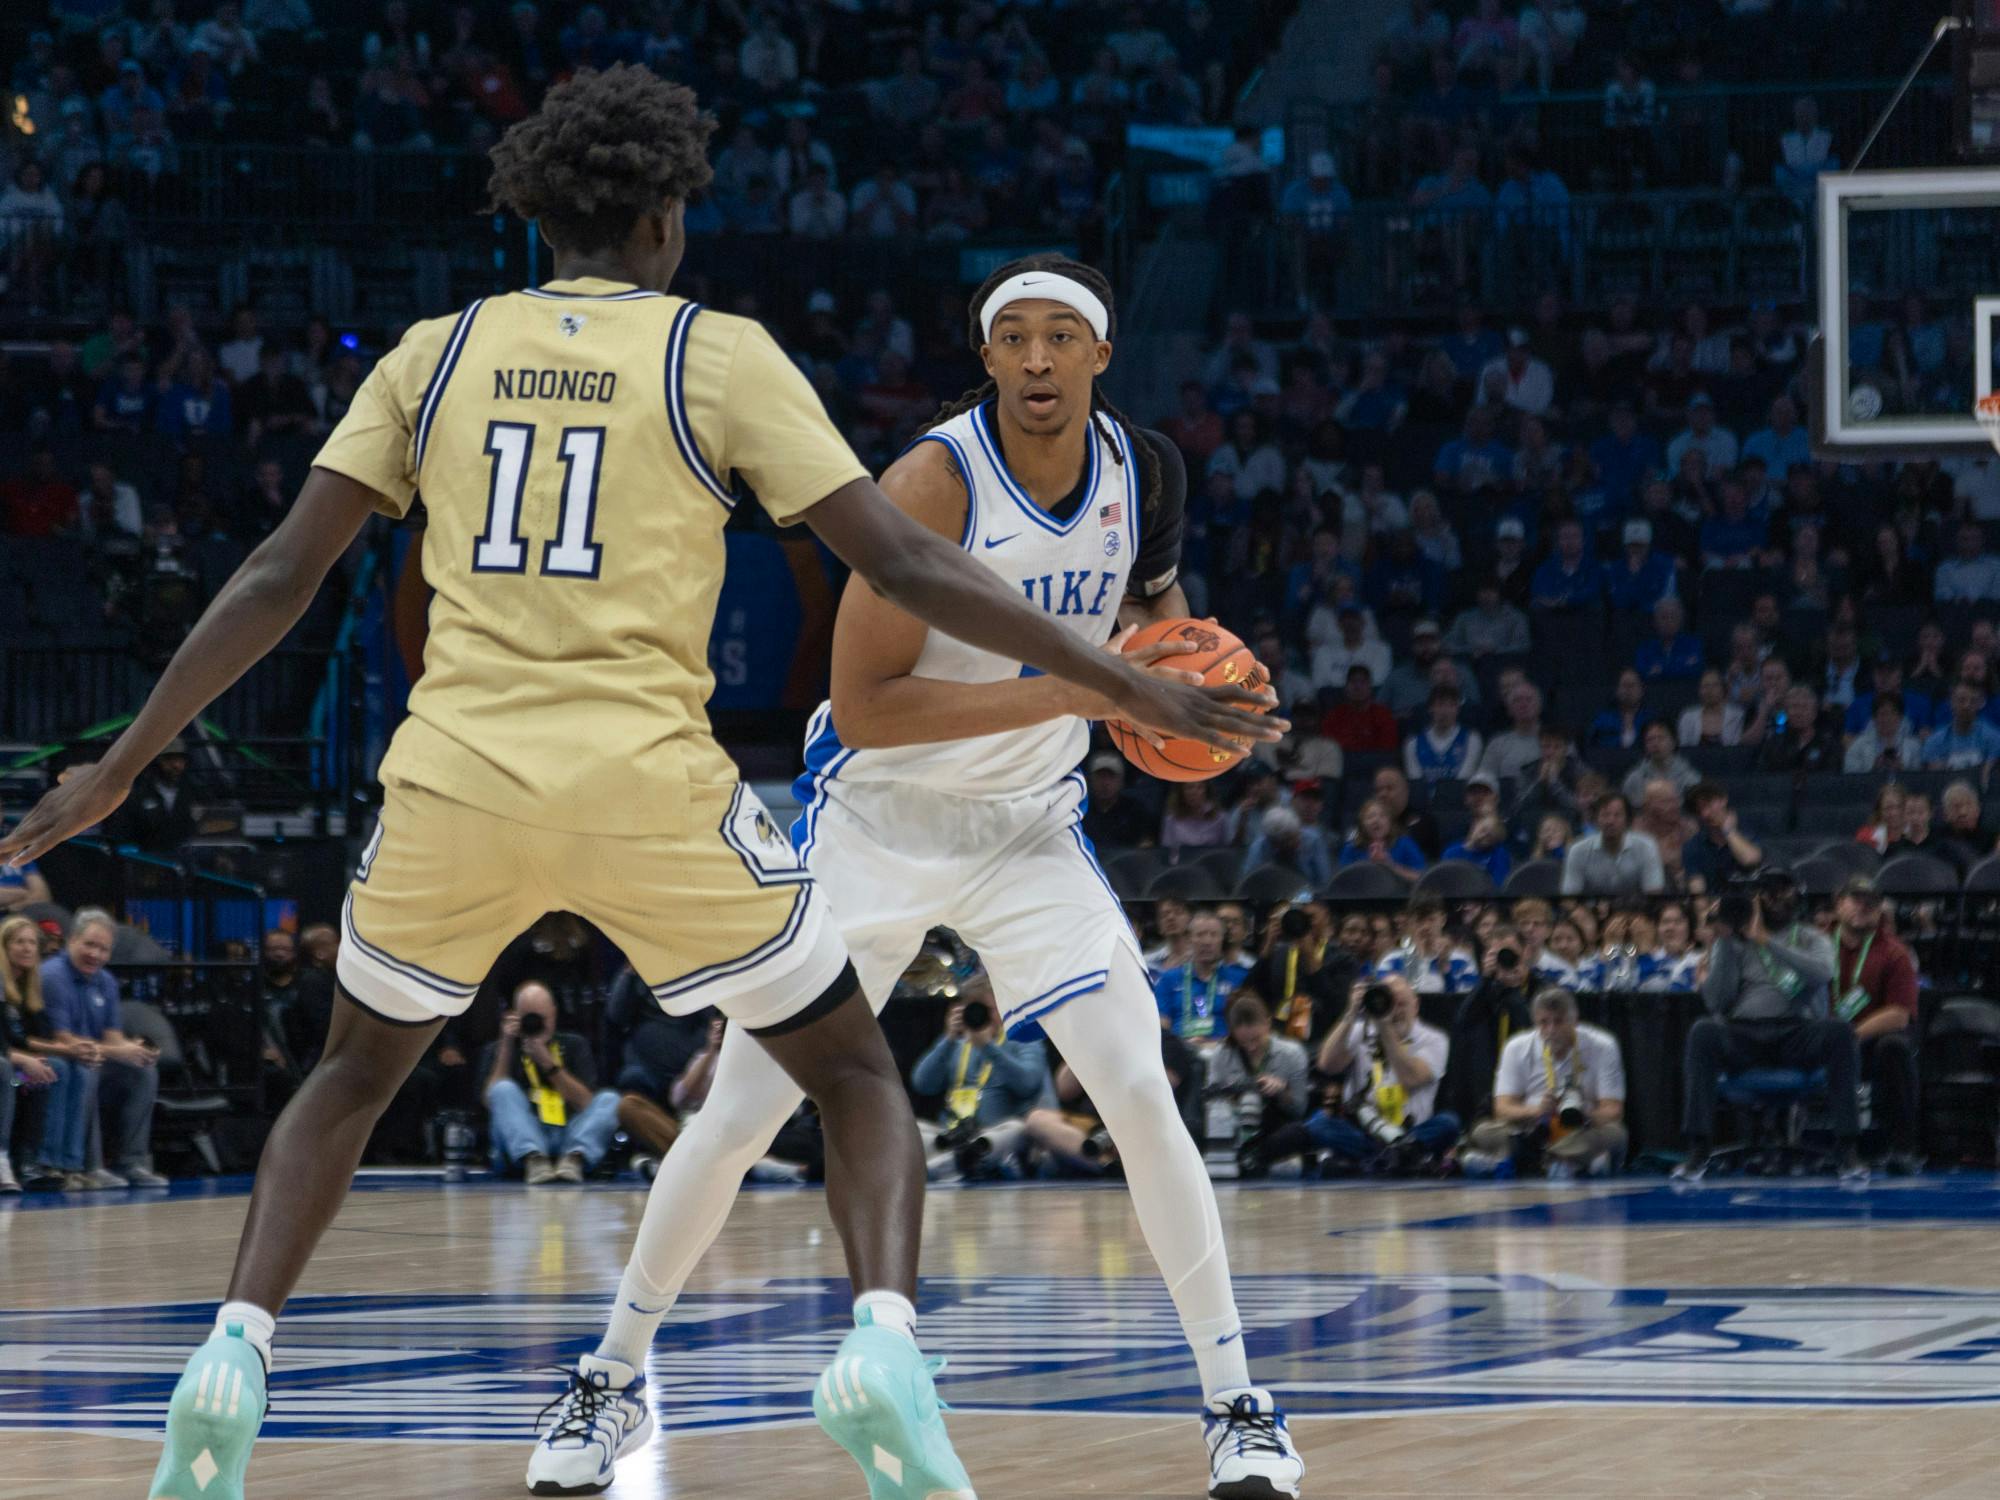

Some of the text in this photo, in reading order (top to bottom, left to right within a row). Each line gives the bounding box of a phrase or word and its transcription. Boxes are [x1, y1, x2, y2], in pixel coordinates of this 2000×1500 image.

[494, 369, 616, 403] NDONGO
[472, 420, 606, 581] 11
[1022, 570, 1117, 616] UKE
